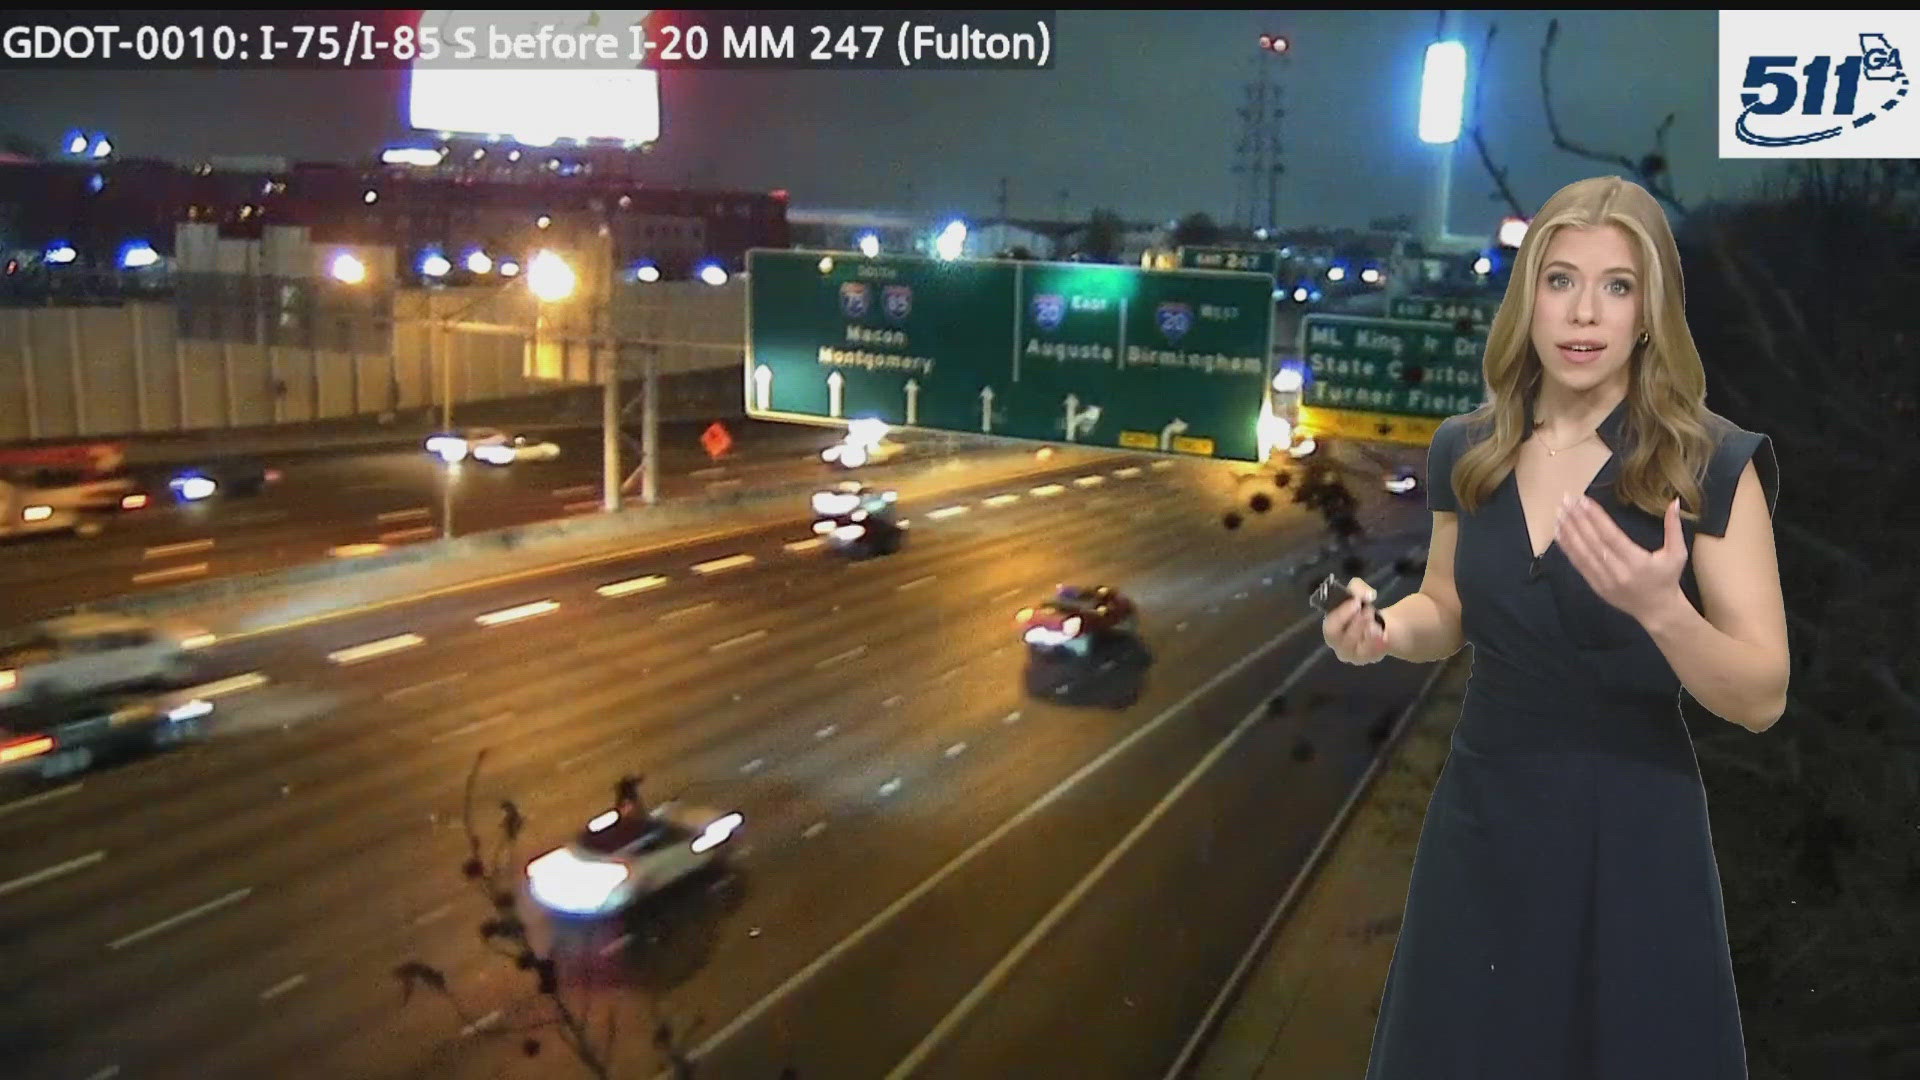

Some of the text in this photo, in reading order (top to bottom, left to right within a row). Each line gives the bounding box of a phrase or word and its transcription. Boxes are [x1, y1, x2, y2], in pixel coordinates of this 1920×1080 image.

[1162, 312, 1189, 331] 20
[846, 325, 906, 346] Macon
[1356, 329, 1403, 356] King
[818, 346, 935, 374] Montgomery
[1026, 339, 1113, 362] Augusta
[1127, 346, 1262, 373] Birmingham
[1310, 353, 1480, 385] State Cpitol
[1315, 381, 1472, 414] Turner Field
